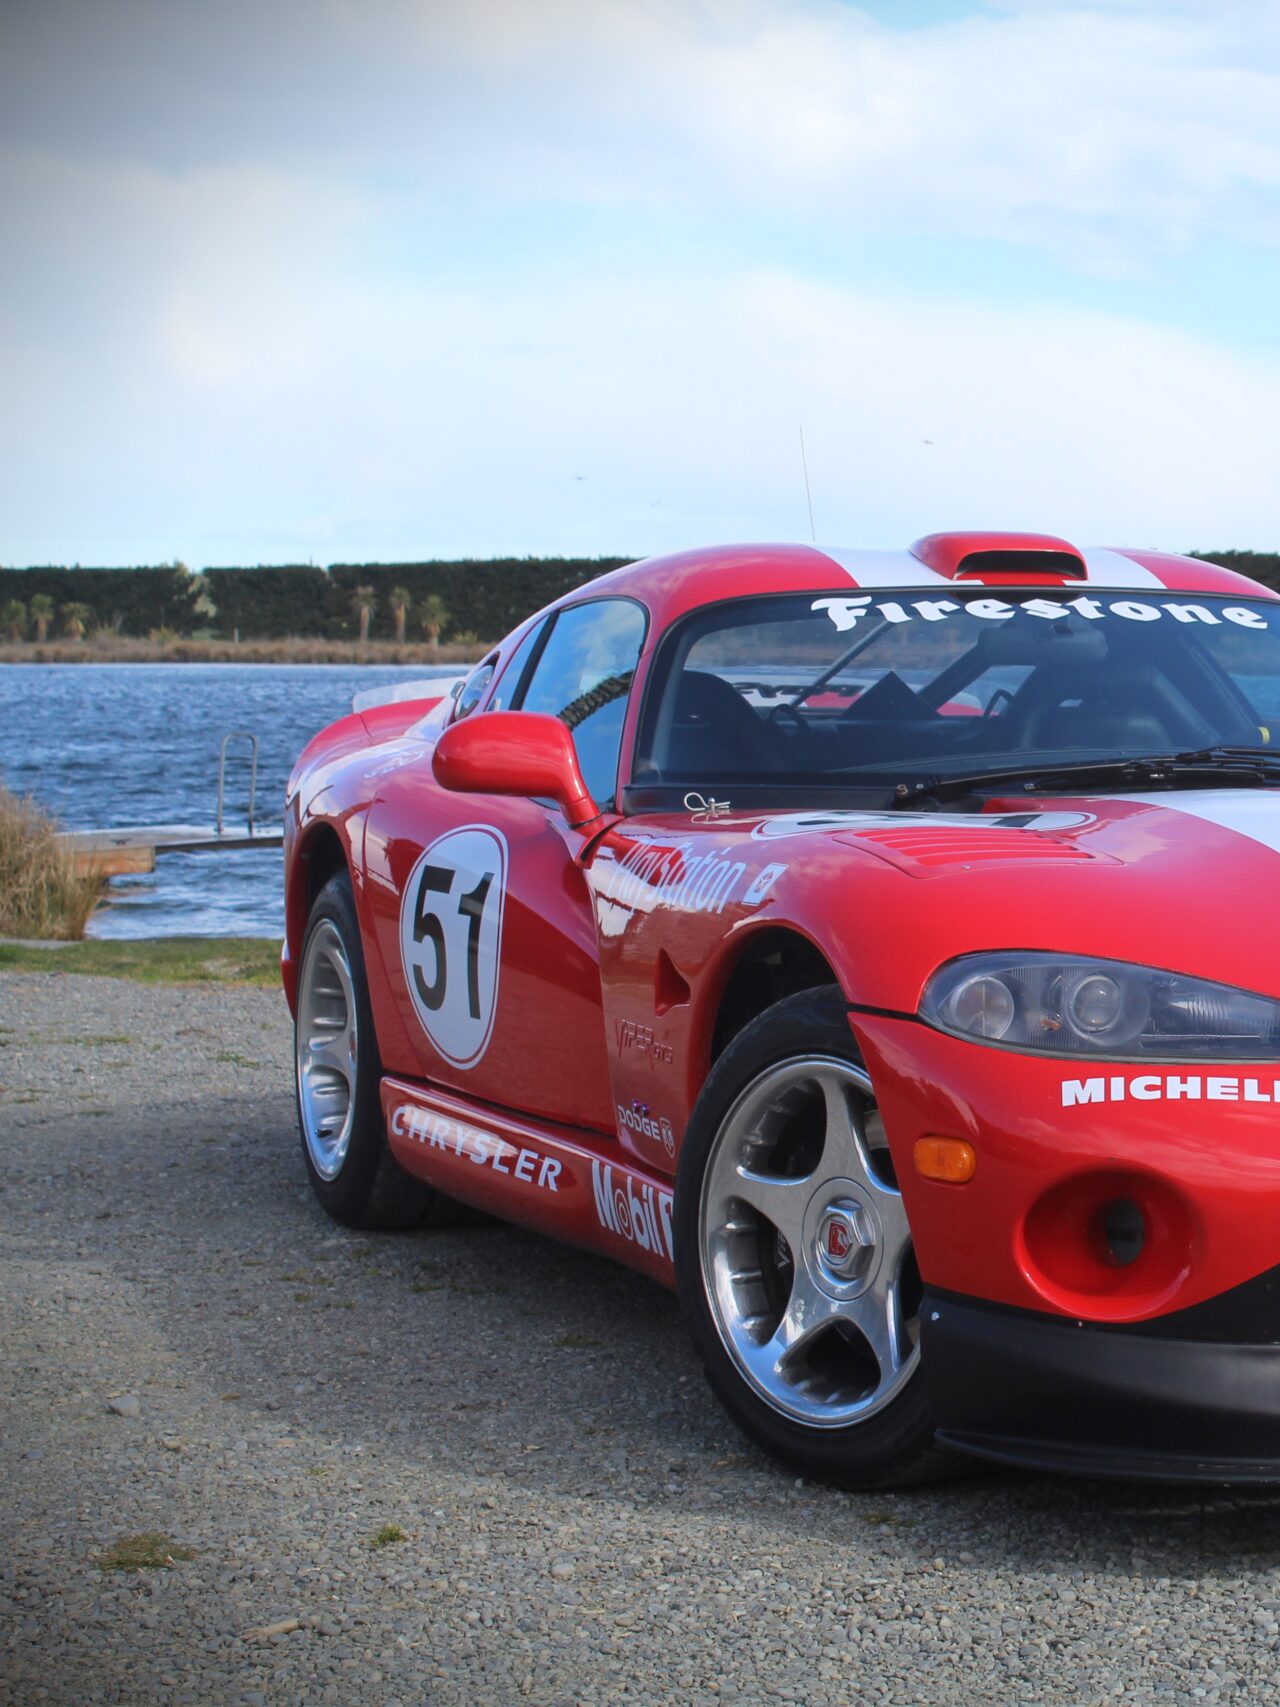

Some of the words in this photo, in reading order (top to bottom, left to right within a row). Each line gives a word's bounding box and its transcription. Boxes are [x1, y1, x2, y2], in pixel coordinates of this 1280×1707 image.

[811, 596, 1268, 631] Firestone
[413, 865, 495, 1020] 51
[391, 1106, 562, 1192] CHRYSLER
[618, 1104, 662, 1141] DODGE
[592, 1158, 664, 1257] Mobil
